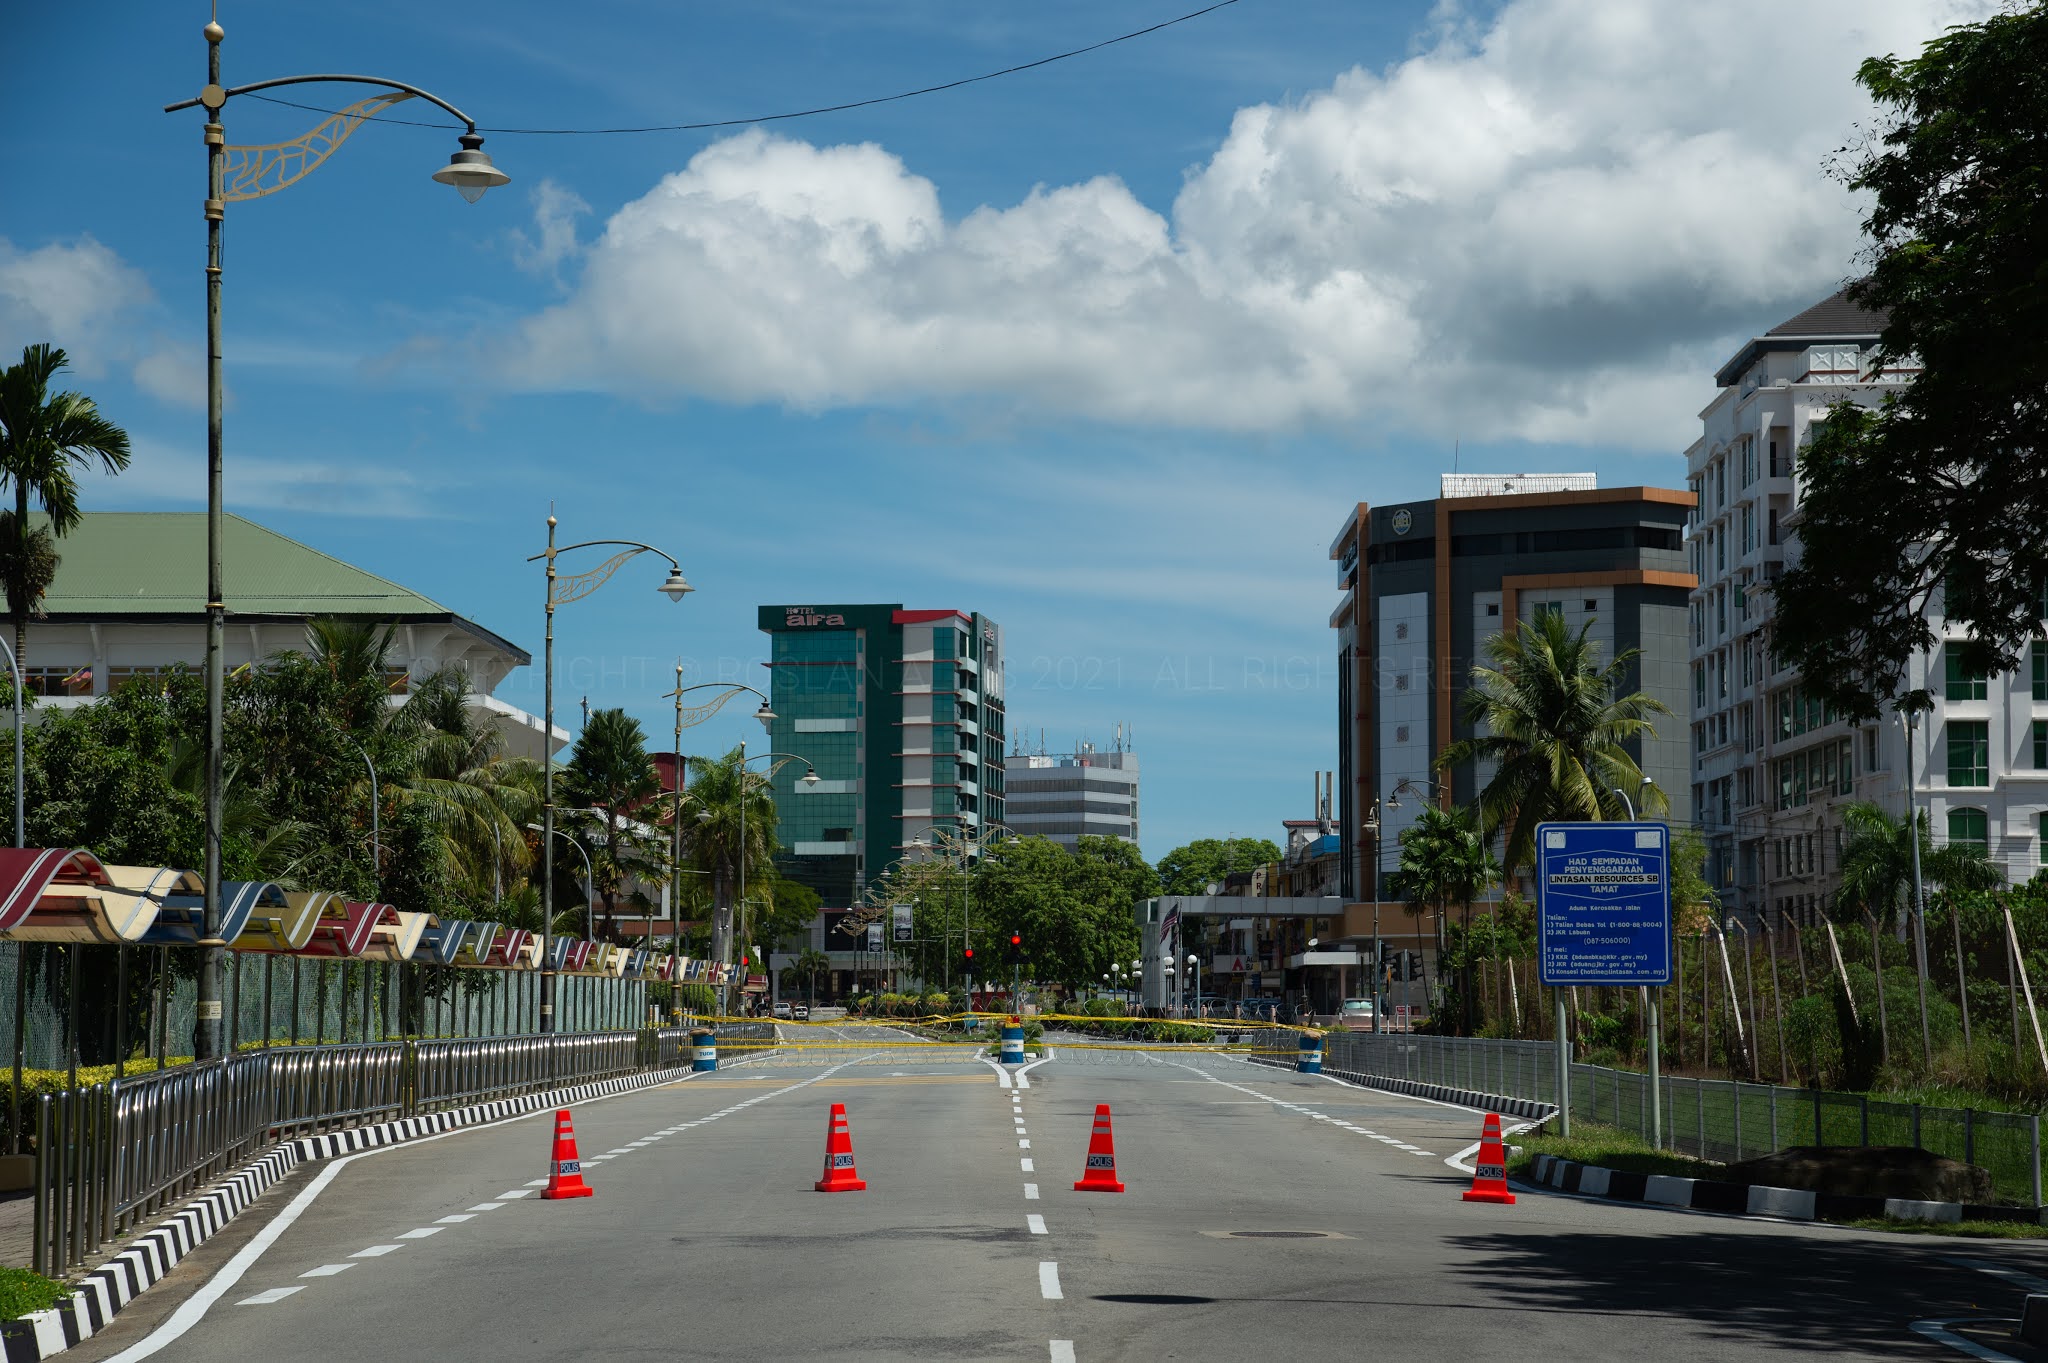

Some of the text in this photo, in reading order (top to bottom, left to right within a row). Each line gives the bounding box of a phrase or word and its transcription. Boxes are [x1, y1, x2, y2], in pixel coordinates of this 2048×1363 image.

[1568, 857, 1639, 865] HAD SEMPADAN
[1550, 875, 1591, 883] LINTASAN
[1594, 875, 1644, 883] RESOURCES
[1590, 885, 1619, 893] TAMAT
[834, 1156, 853, 1166] POLIS
[1088, 1157, 1113, 1167] POLIS
[560, 1162, 579, 1173] POLIS
[1477, 1167, 1503, 1177] POLIS
